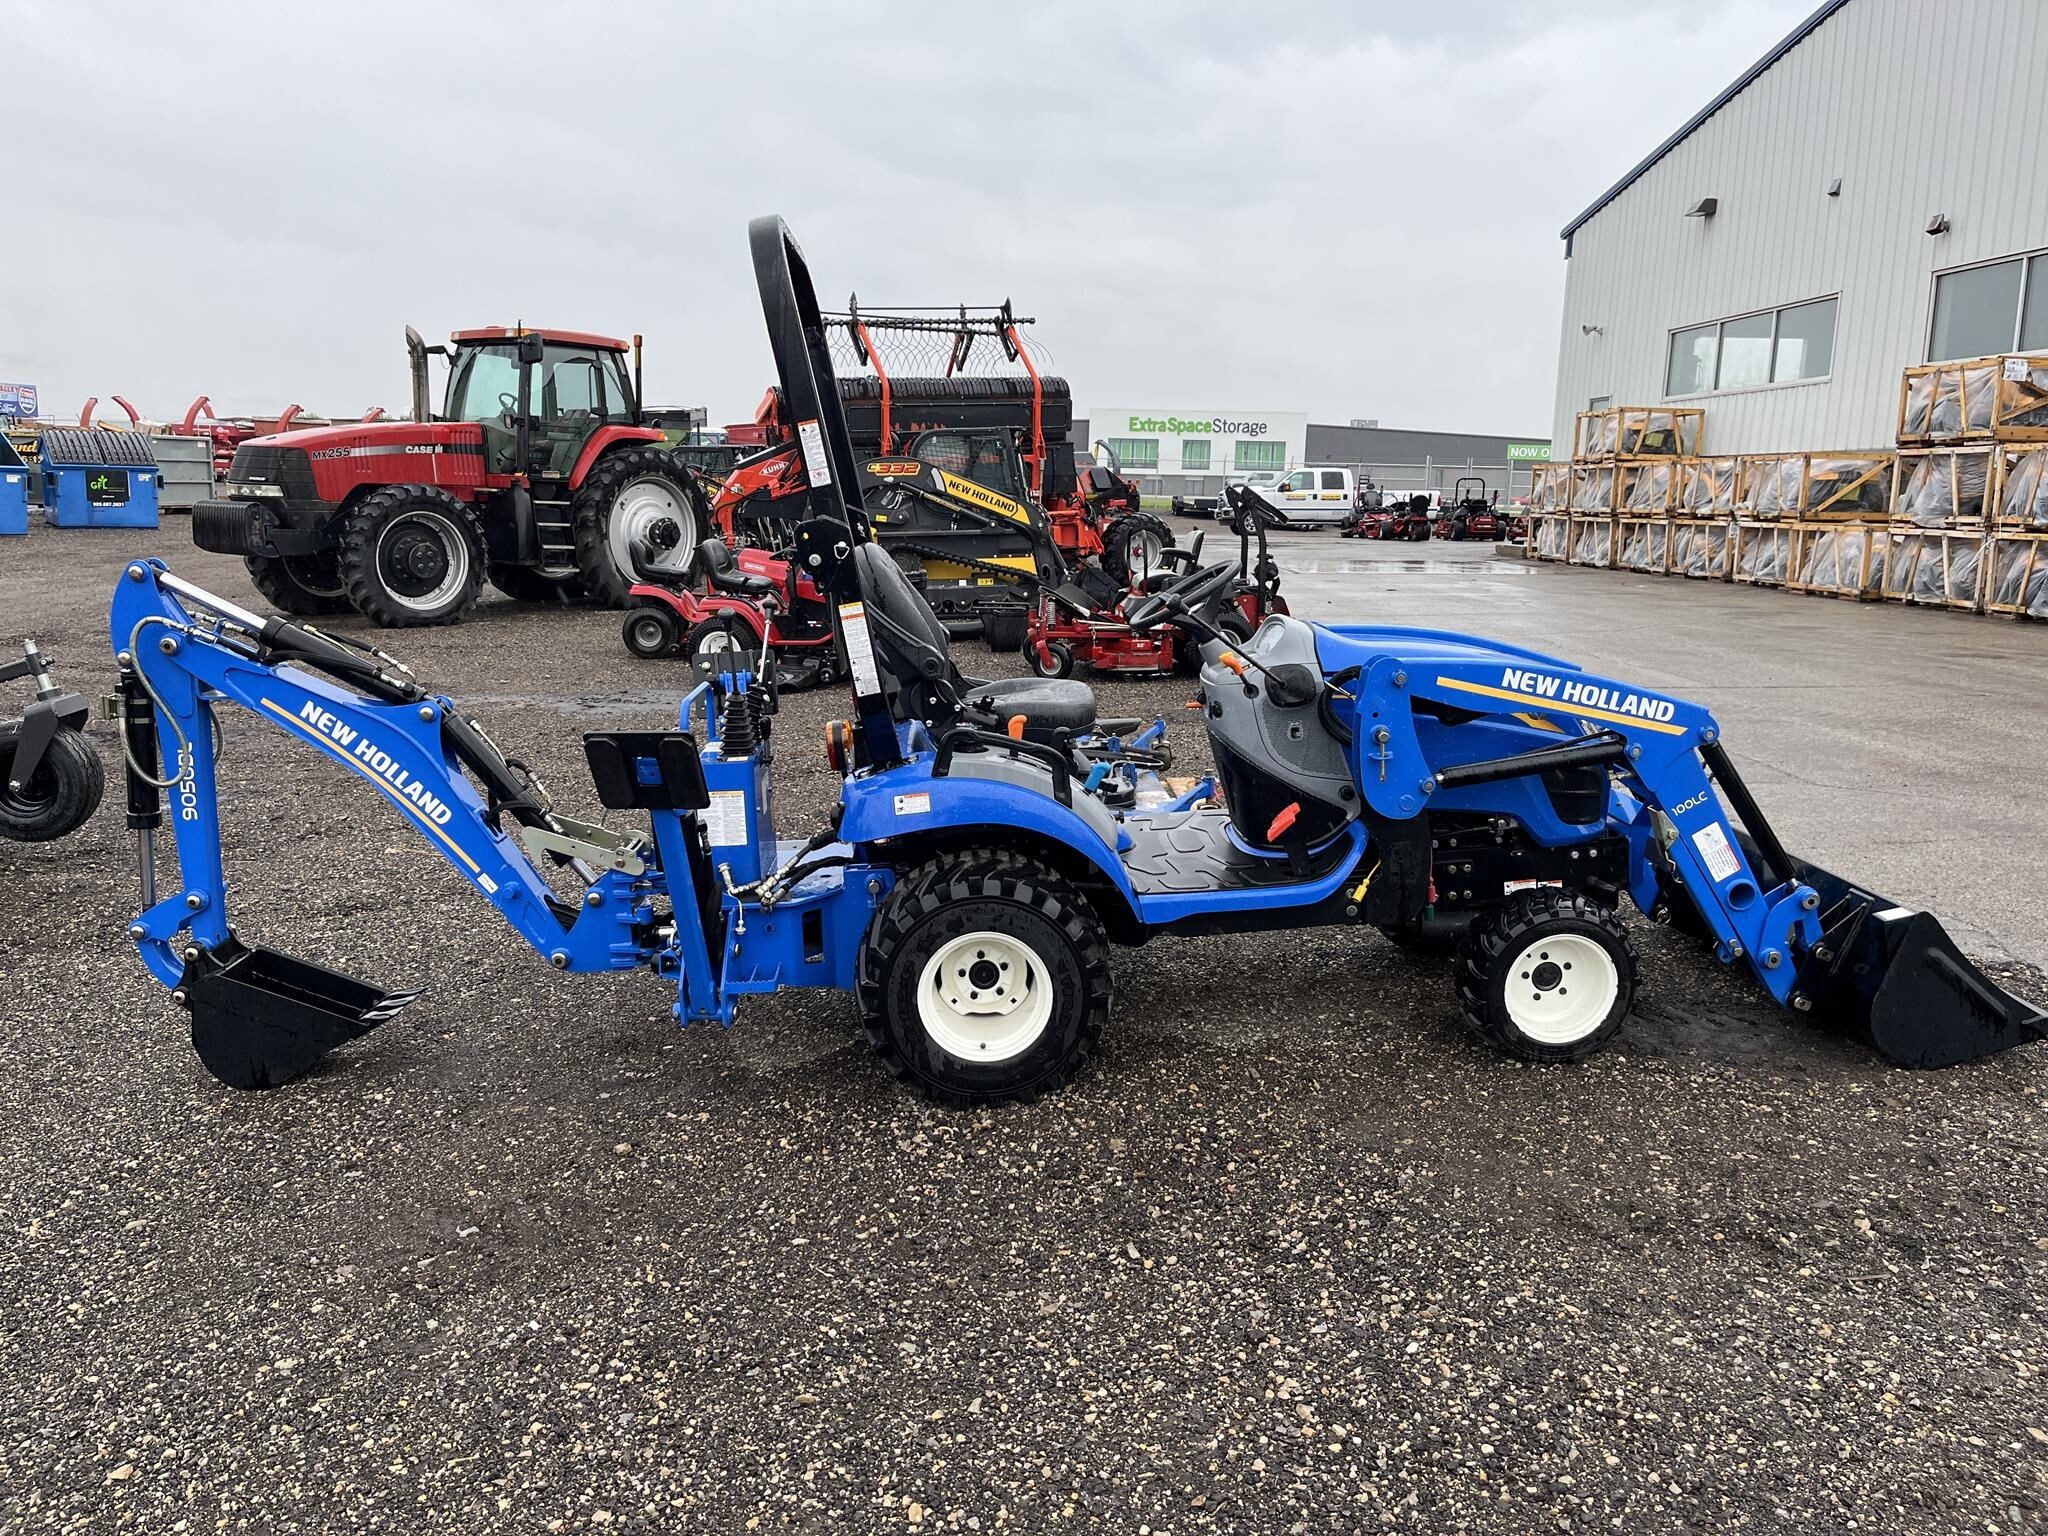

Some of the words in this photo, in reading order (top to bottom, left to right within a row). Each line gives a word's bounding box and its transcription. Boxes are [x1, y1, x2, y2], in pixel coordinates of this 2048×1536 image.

[312, 446, 350, 460] MX255
[405, 445, 433, 454] CASE
[1510, 447, 1538, 457] NOW
[762, 461, 785, 474] KUHN
[867, 463, 920, 475] C332
[90, 479, 108, 490] GFL
[948, 479, 971, 495] NEW
[971, 488, 1015, 513] HOLLAND
[1501, 667, 1561, 697] NEW
[1562, 681, 1675, 722] HOLLAND
[300, 700, 358, 747] NEW
[354, 738, 452, 825] HOLLAND
[1671, 791, 1708, 817] 100LC
